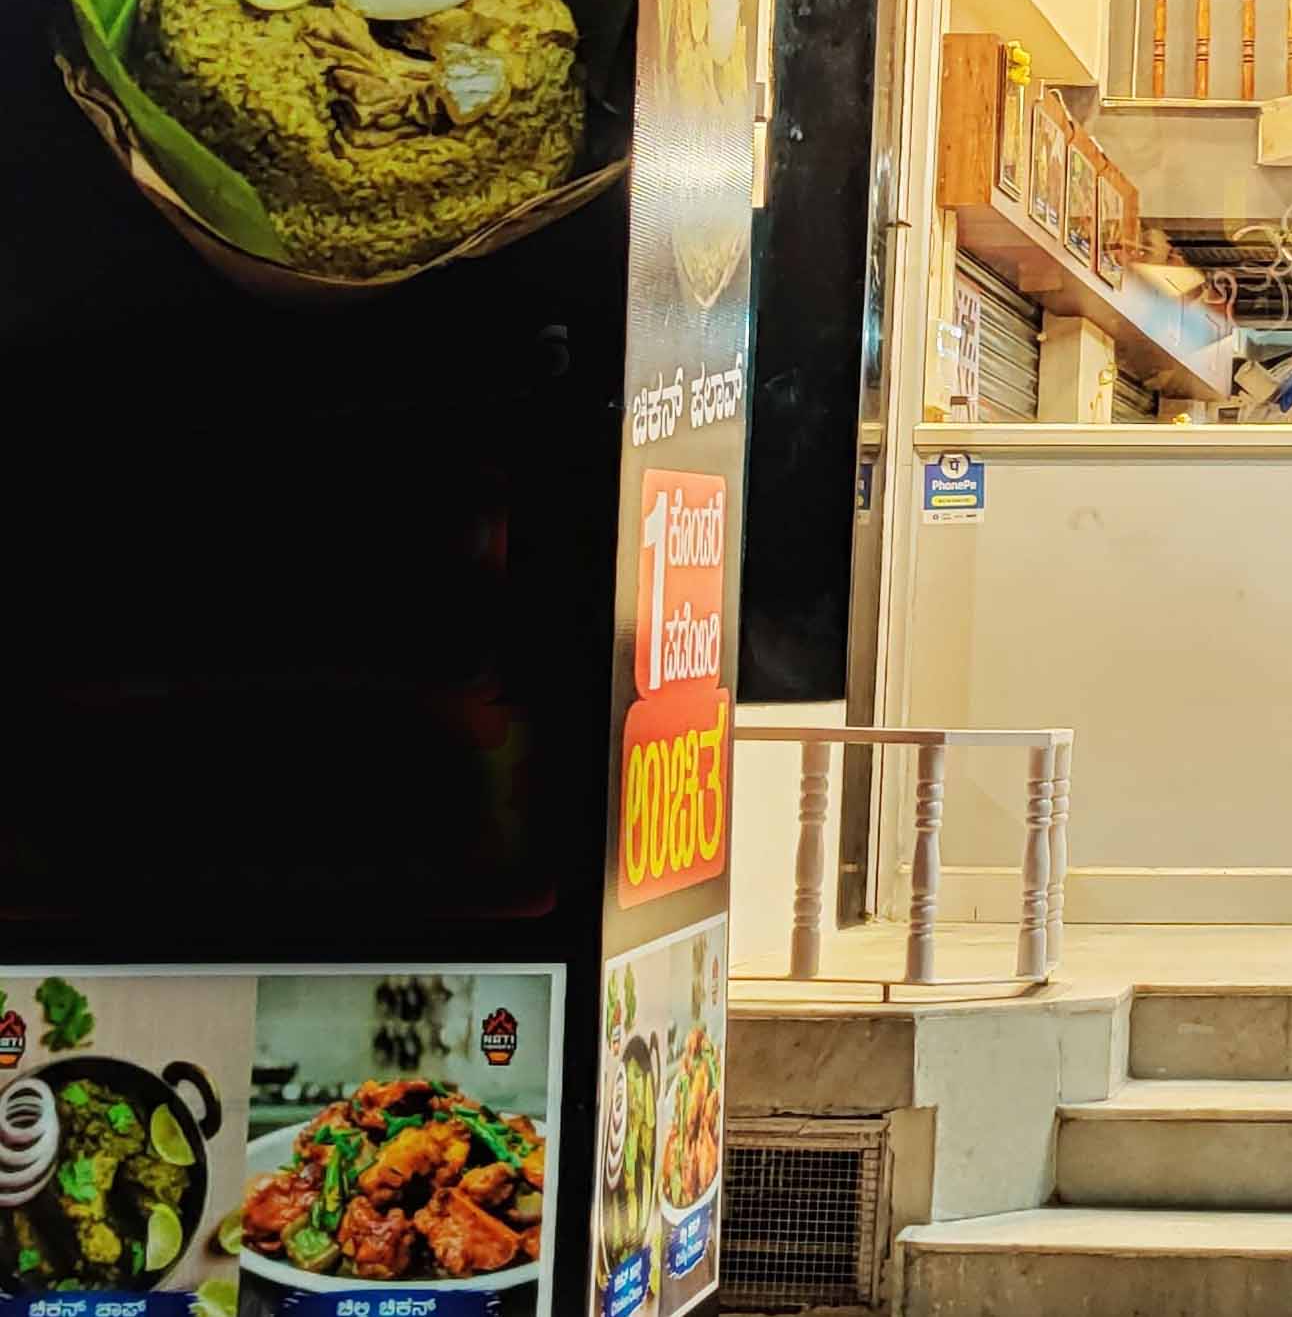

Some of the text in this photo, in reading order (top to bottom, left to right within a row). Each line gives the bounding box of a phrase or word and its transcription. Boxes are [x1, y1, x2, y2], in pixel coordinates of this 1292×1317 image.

[632, 367, 684, 447] ಚಿಕನ್
[644, 490, 668, 691] 1
[625, 702, 725, 886] ಉಚಿತ
